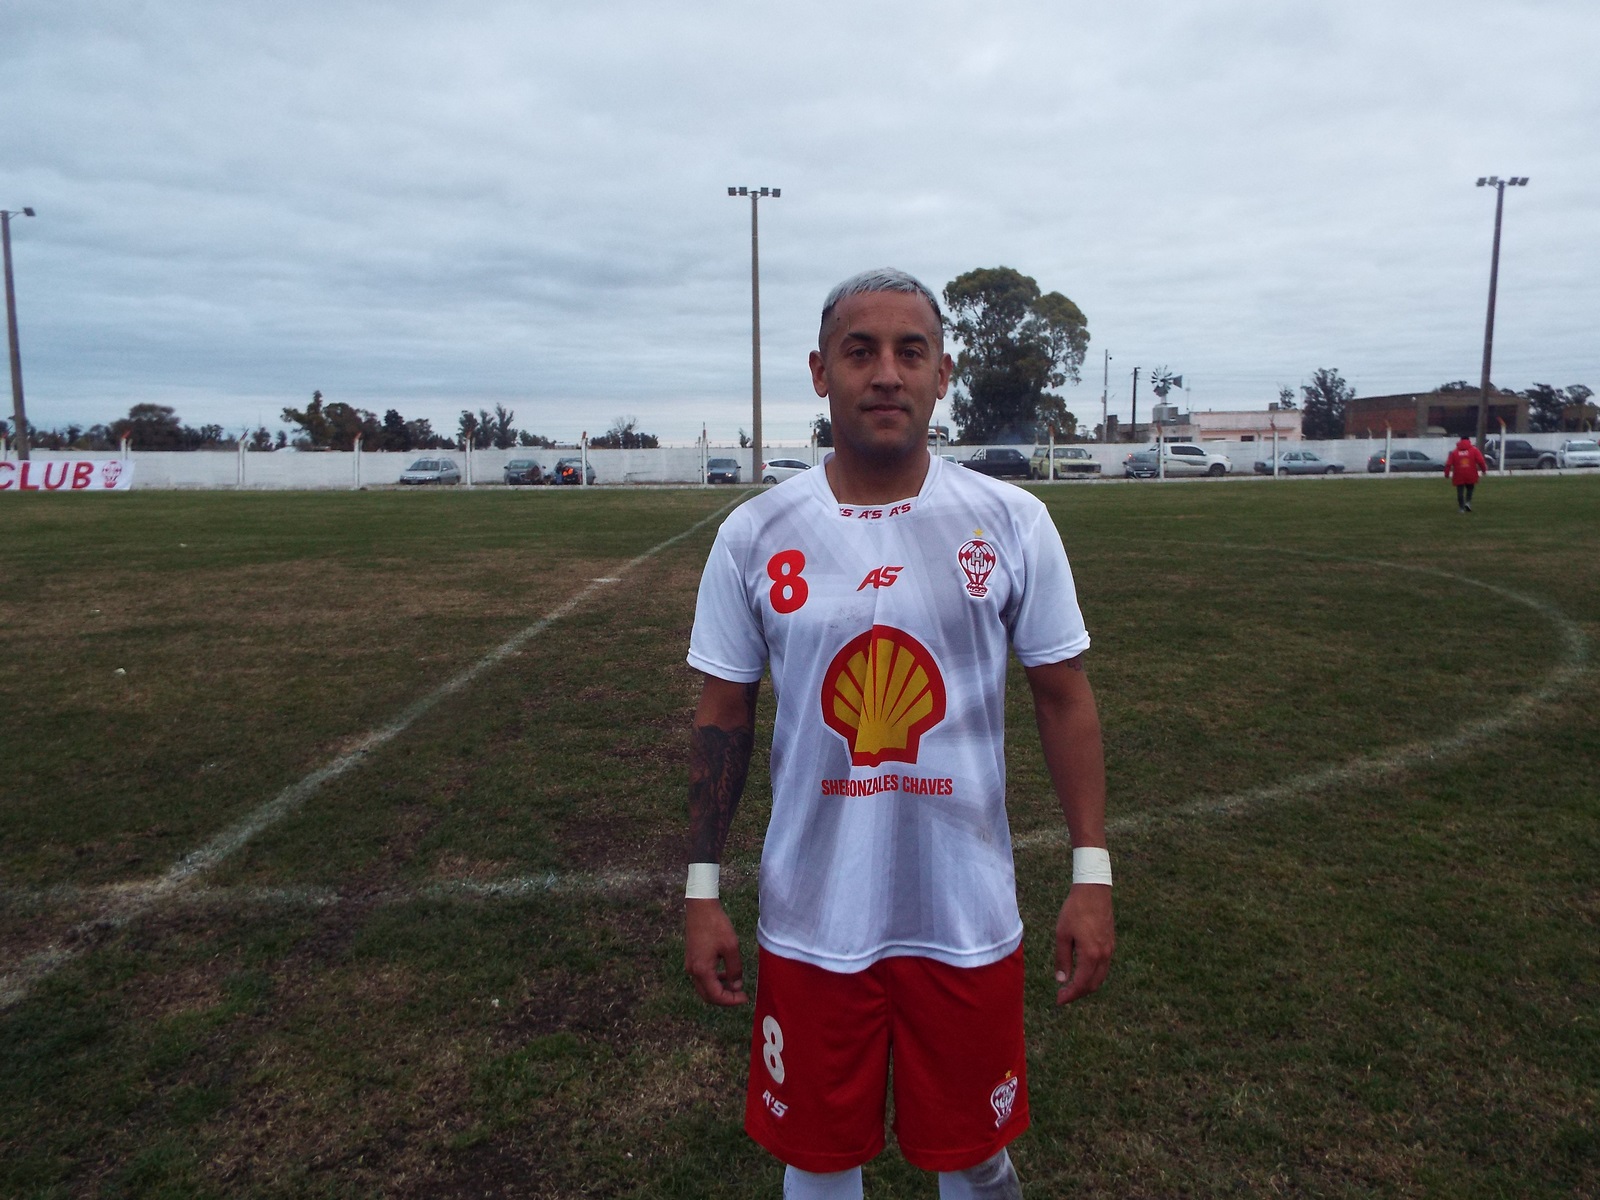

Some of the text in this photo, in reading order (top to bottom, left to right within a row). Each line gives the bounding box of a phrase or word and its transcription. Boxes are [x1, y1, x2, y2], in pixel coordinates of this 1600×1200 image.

[0, 462, 94, 490] CLUB
[767, 549, 808, 614] 8
[902, 776, 953, 795] CHAVES
[762, 1015, 785, 1084] 8
